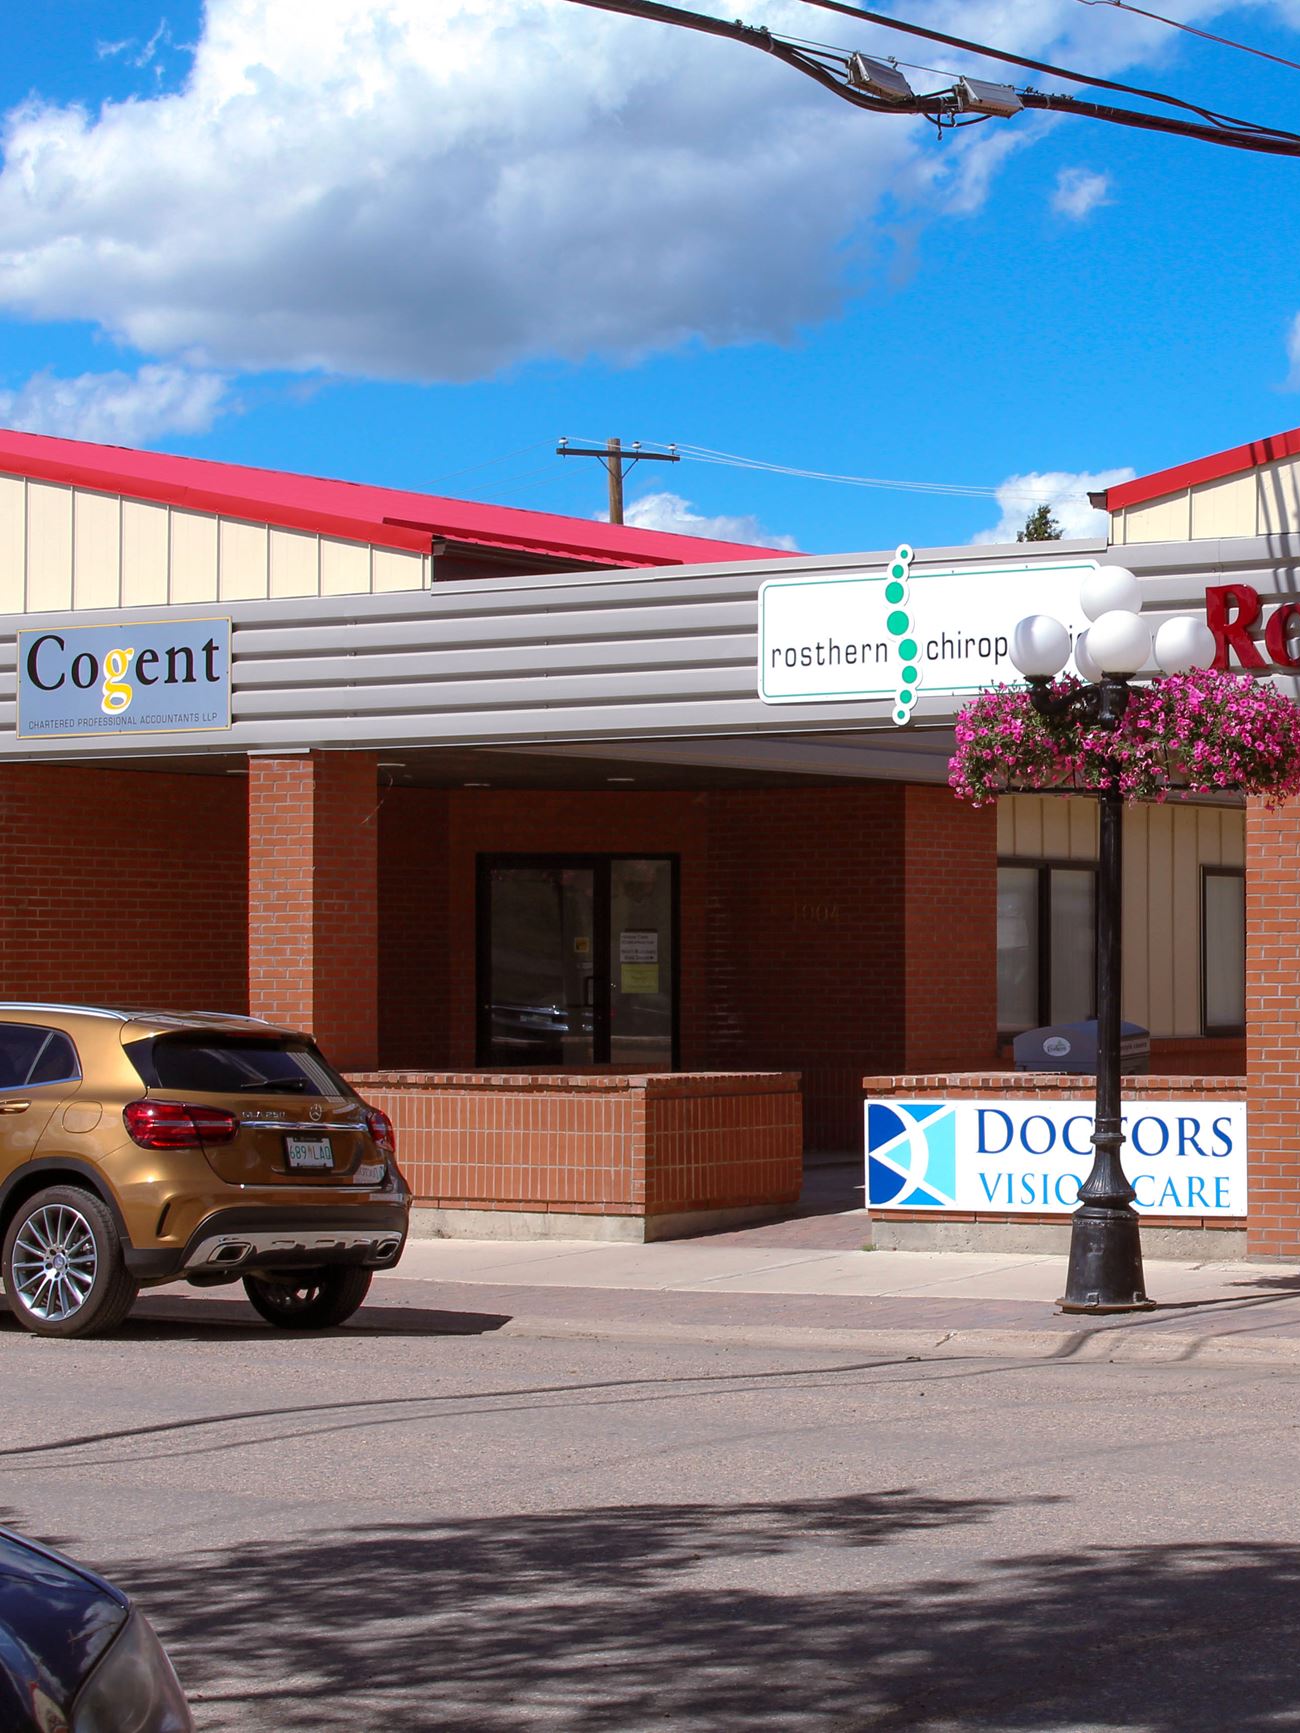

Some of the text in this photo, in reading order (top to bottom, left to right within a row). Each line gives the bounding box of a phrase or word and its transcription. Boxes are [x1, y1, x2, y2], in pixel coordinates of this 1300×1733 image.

[772, 639, 888, 668] rosthern
[26, 634, 221, 715] Cogent
[28, 712, 218, 730] CHARTERED PROFESSIONAL ACCOUNTANTS LLP
[977, 1108, 1233, 1158] DOCORS
[289, 1145, 307, 1160] 689
[979, 1172, 1231, 1209] VISIO CARE
